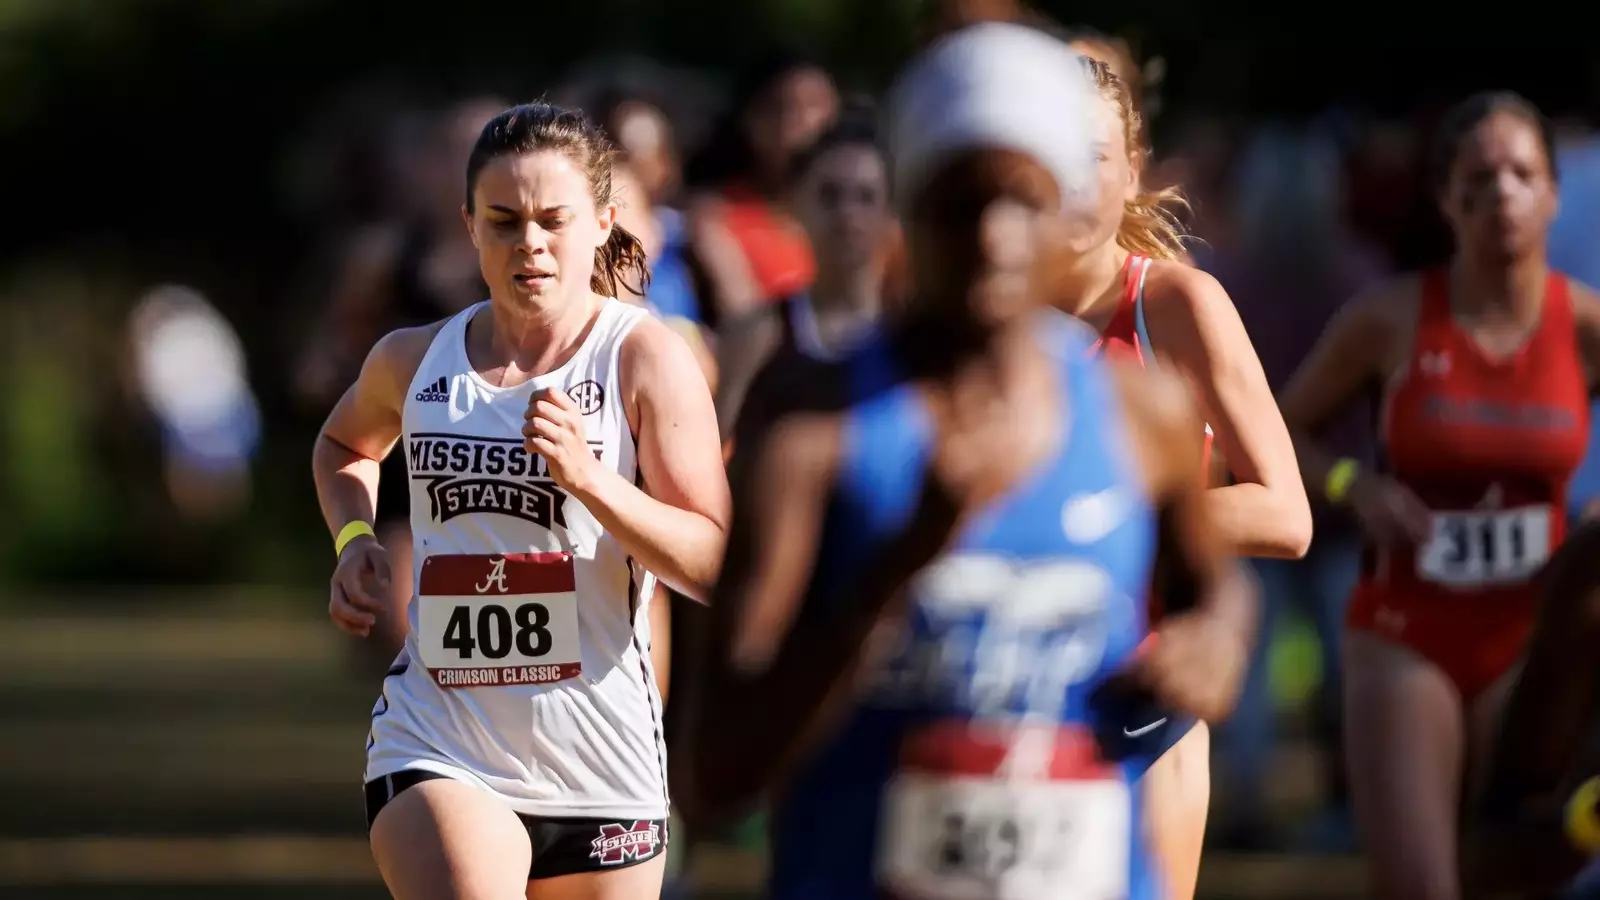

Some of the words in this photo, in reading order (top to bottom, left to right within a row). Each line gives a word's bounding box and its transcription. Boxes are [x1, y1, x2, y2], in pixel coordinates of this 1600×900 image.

[415, 391, 450, 403] adidas
[567, 380, 604, 415] SEC
[410, 440, 603, 477] MISSISSI
[445, 484, 539, 519] STATE
[475, 558, 509, 593] A
[442, 602, 553, 659] 408
[438, 669, 499, 685] CRIMSON
[502, 665, 561, 682] CLASSIC
[606, 831, 649, 849] STATE
